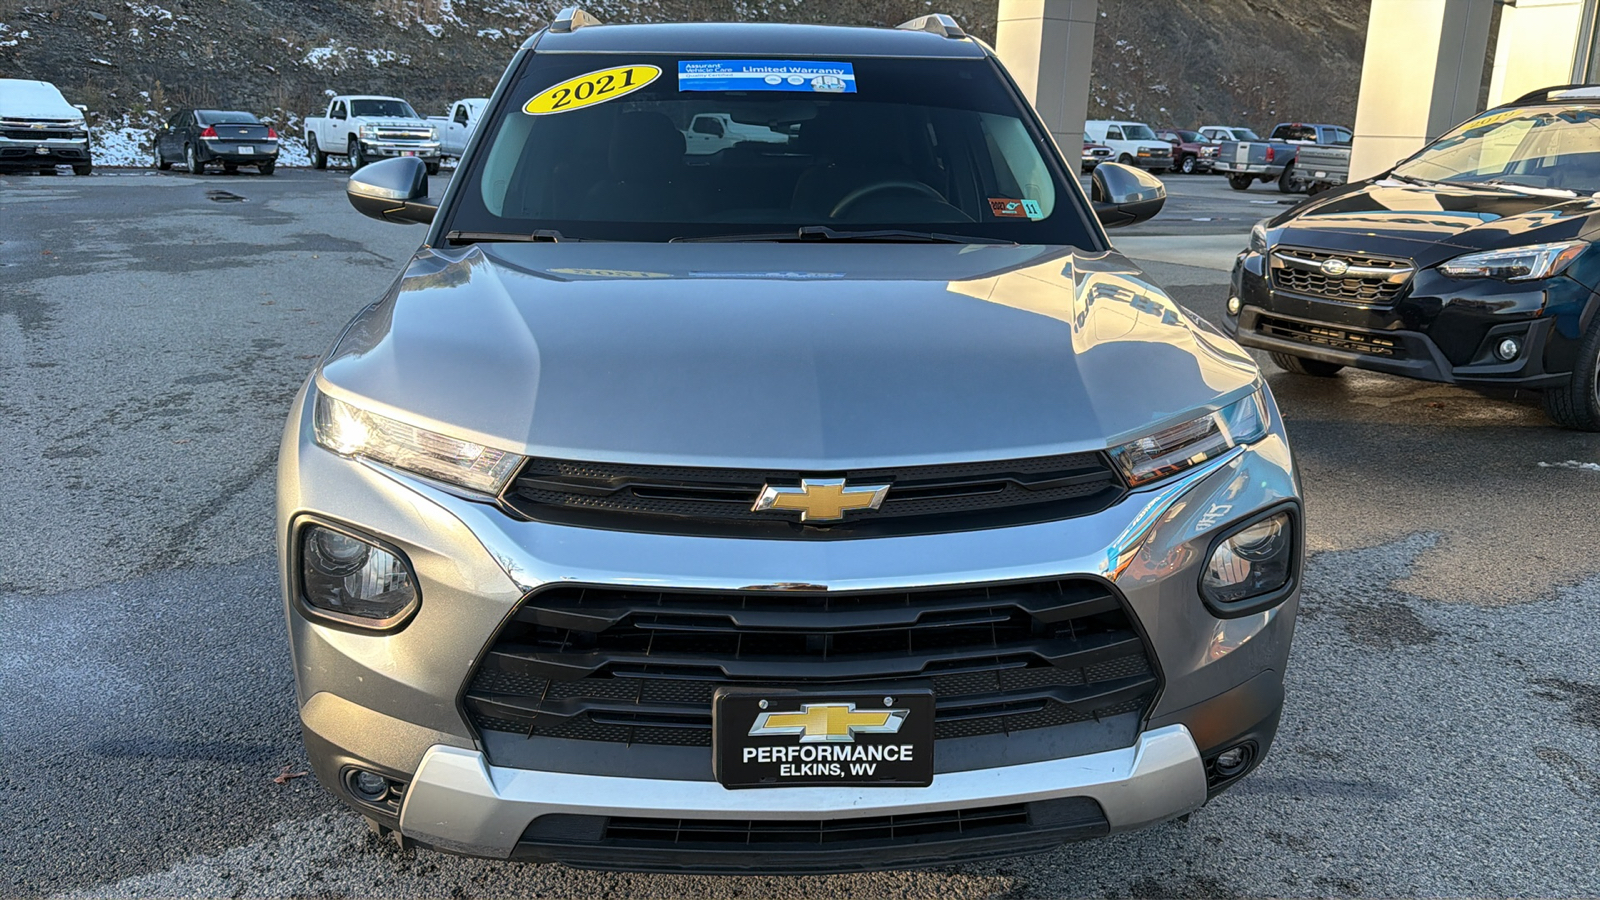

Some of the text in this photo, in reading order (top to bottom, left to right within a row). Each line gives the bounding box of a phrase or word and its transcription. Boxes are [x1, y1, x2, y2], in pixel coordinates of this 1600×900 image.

[789, 67, 845, 75] Warranty
[551, 69, 636, 110] 2021
[1025, 203, 1038, 215] 11
[742, 745, 914, 763] PERFORMANCE
[780, 763, 877, 778] ELKINS, WV
